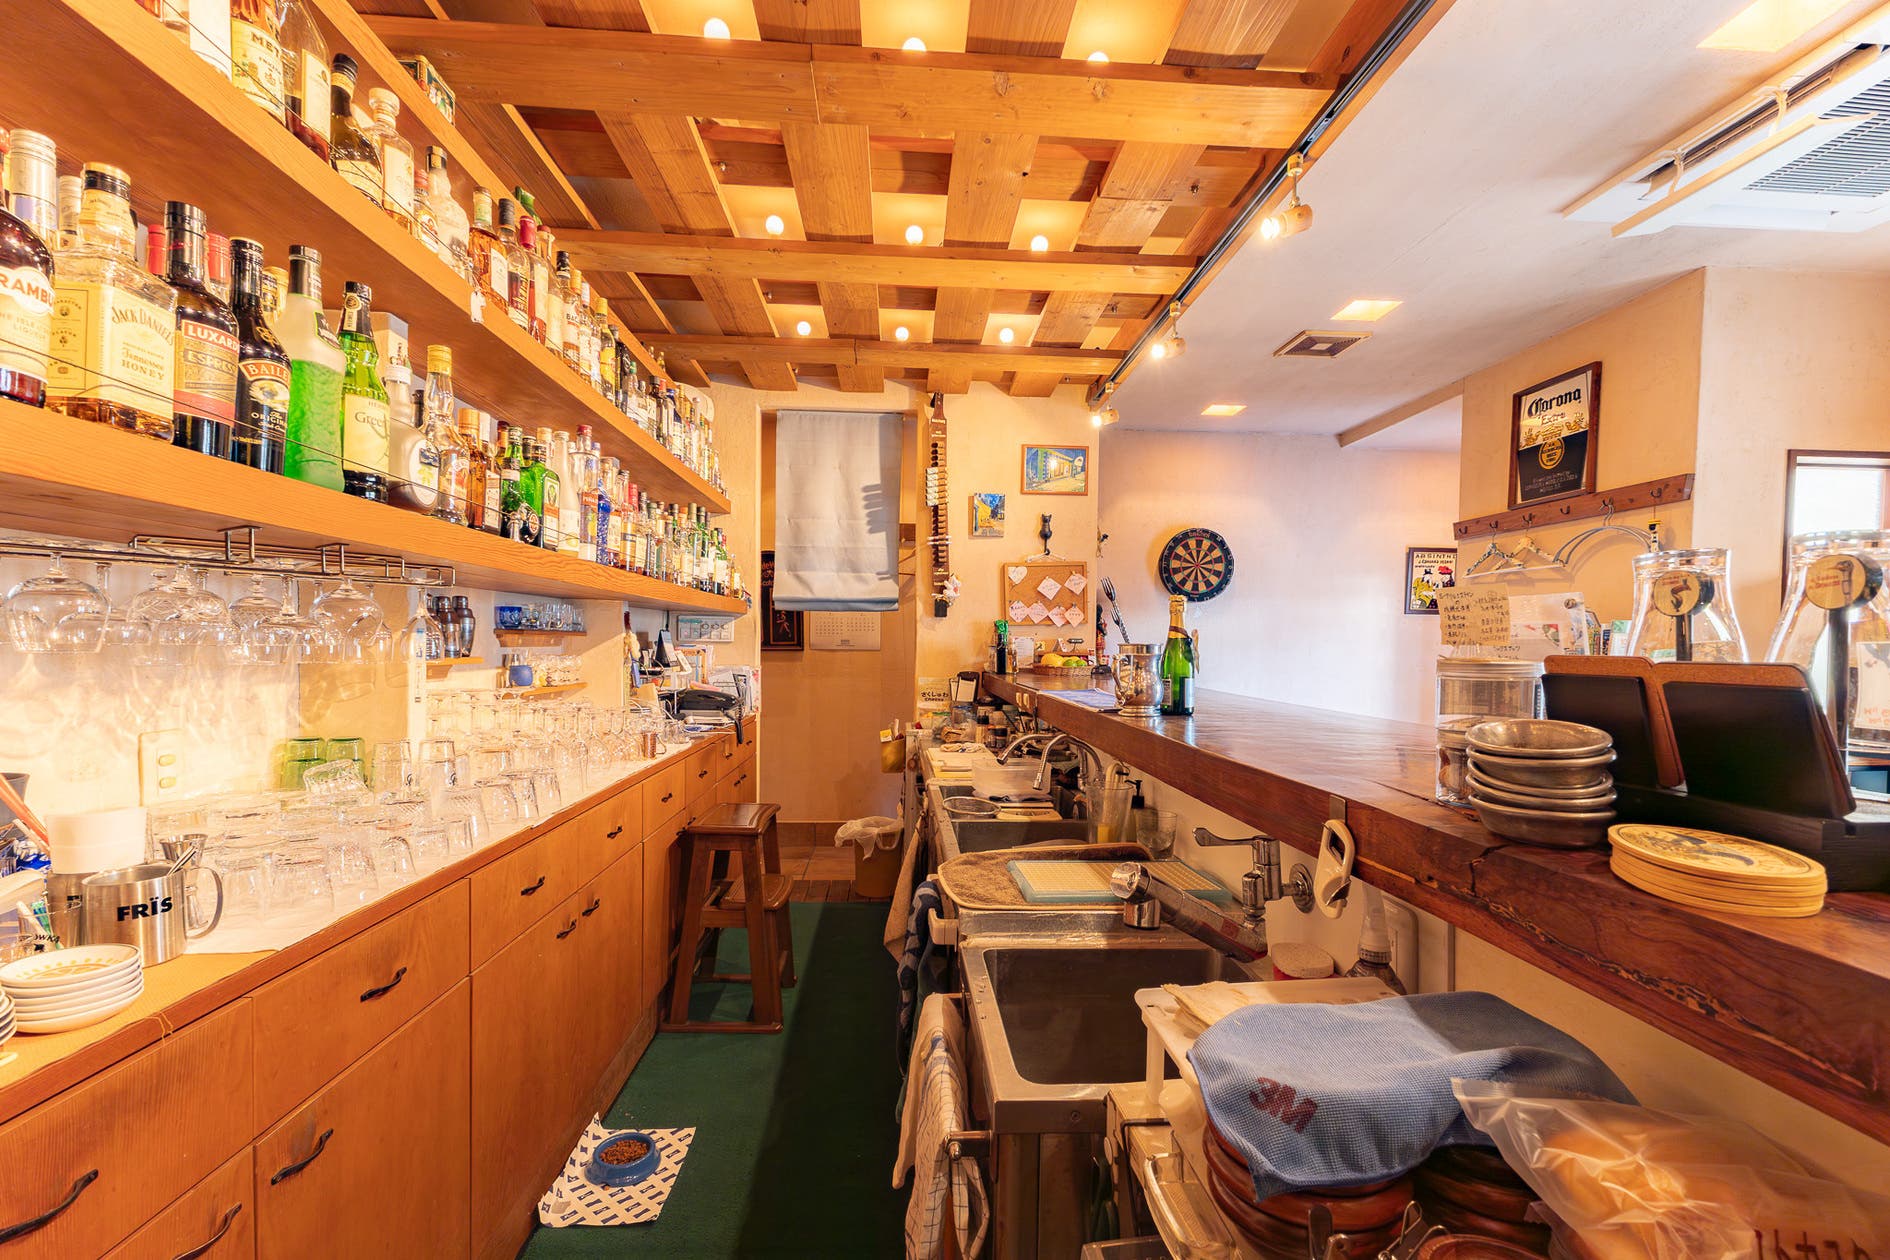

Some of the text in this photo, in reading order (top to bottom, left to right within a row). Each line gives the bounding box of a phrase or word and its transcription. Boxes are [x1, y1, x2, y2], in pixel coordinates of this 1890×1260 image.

[1527, 387, 1582, 418] Corona
[116, 896, 173, 922] FRÏS
[1248, 1076, 1318, 1134] 3M
